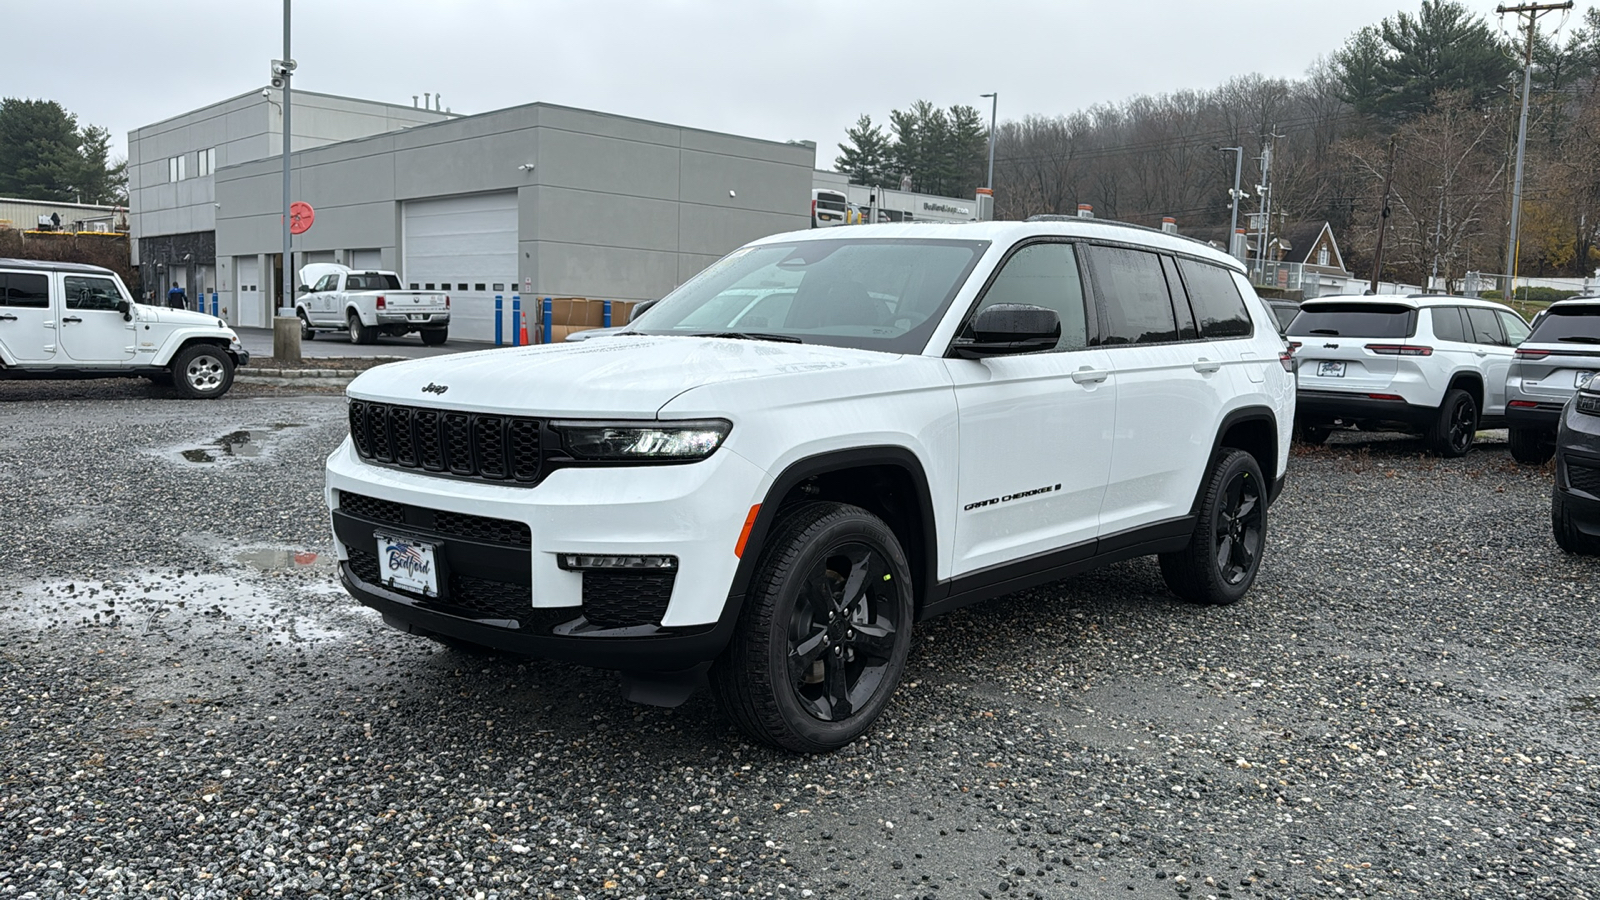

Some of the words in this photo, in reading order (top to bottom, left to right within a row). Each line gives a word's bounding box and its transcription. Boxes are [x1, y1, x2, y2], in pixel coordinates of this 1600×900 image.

[421, 382, 449, 395] Jeep
[964, 498, 999, 511] GRAND
[1001, 485, 1053, 502] CHEROKEE
[386, 545, 431, 577] Bedford
